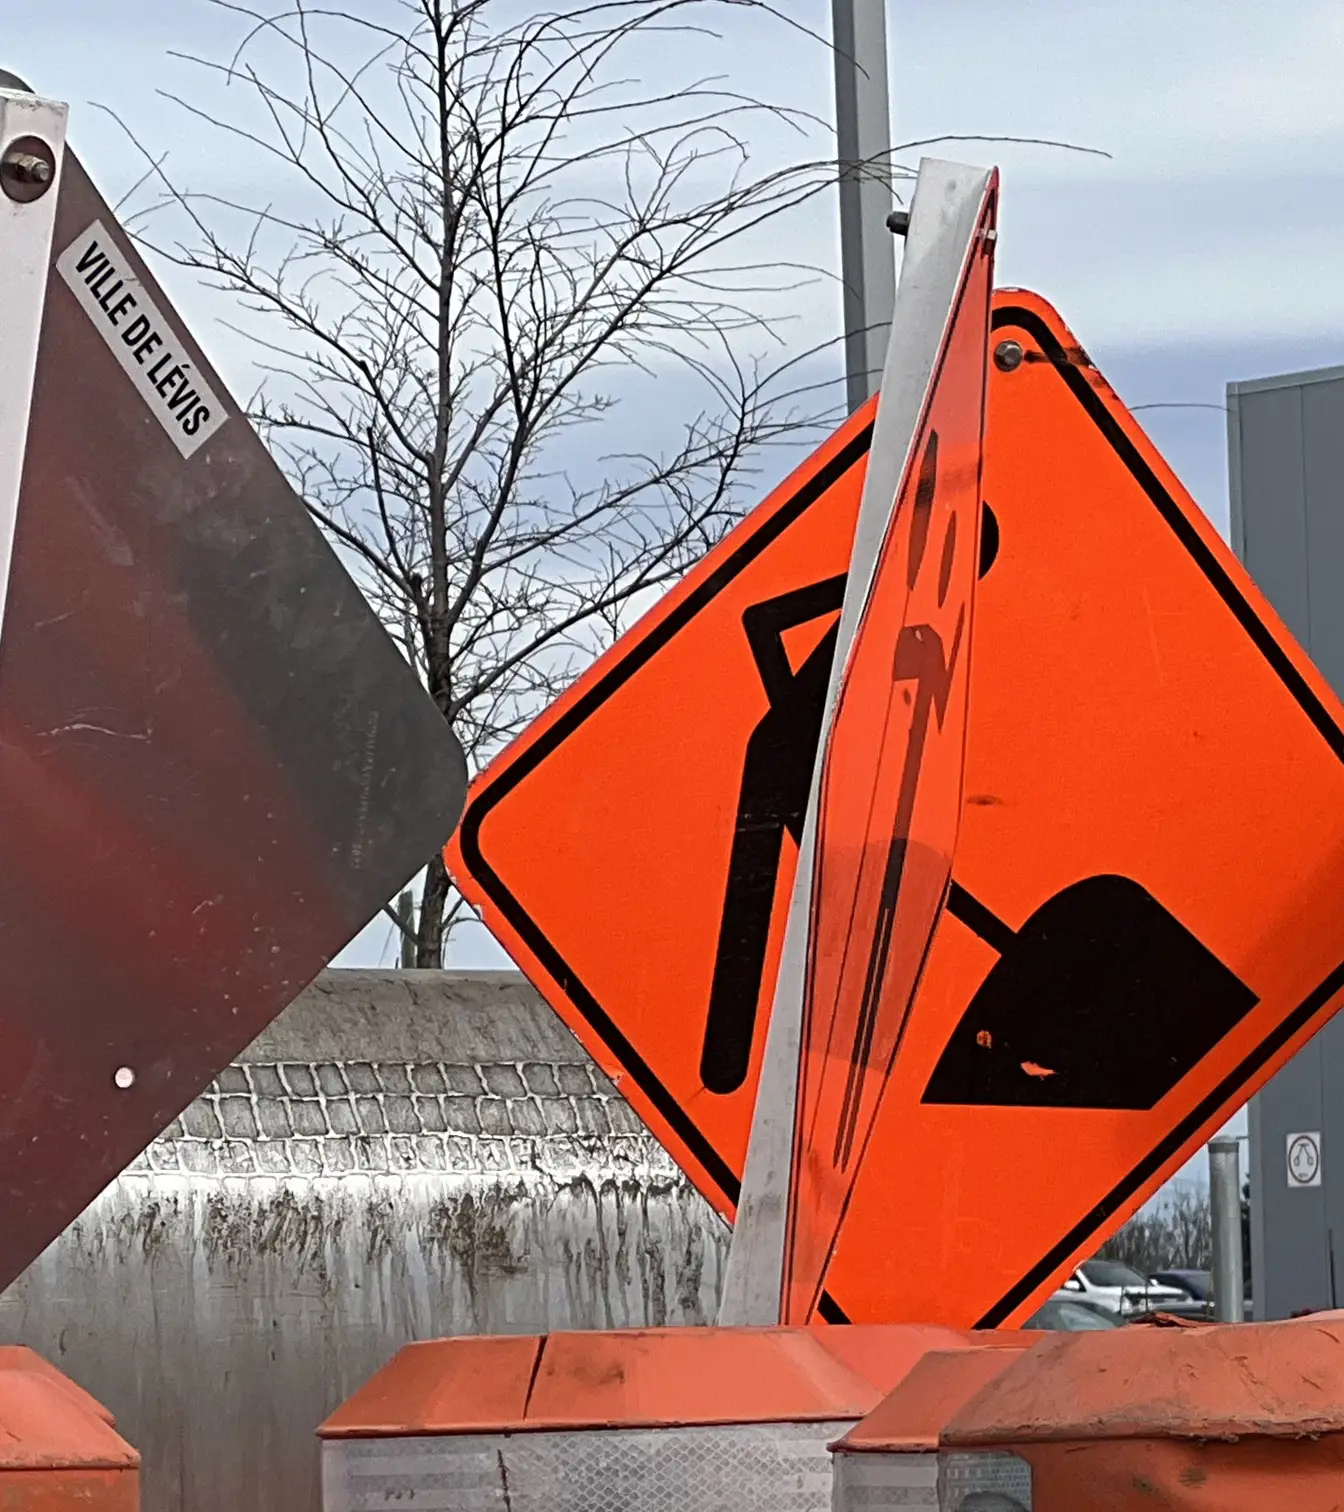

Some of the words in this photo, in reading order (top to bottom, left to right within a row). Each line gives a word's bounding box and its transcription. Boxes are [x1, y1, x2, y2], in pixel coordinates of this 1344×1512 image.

[76, 240, 137, 326] VILLE
[121, 314, 163, 365] DE
[147, 352, 210, 436] LÉVIS
